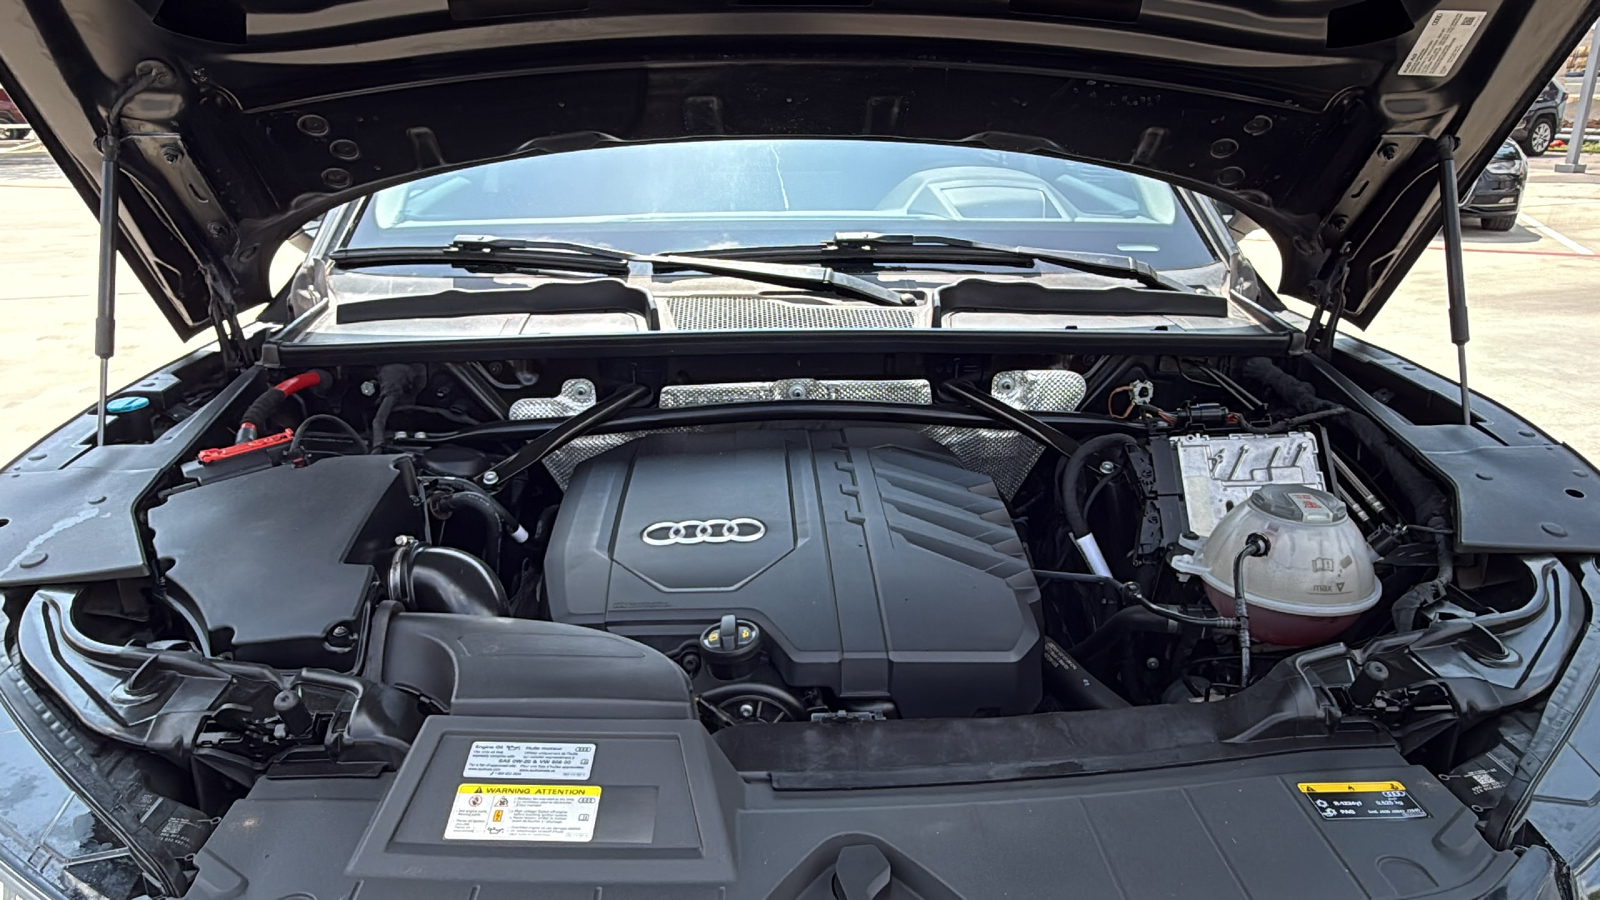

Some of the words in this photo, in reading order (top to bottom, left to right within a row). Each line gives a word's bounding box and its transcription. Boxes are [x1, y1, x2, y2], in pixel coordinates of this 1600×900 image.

[1313, 584, 1333, 592] max
[486, 787, 531, 795] WARNING
[534, 788, 586, 796] ATTENTION
